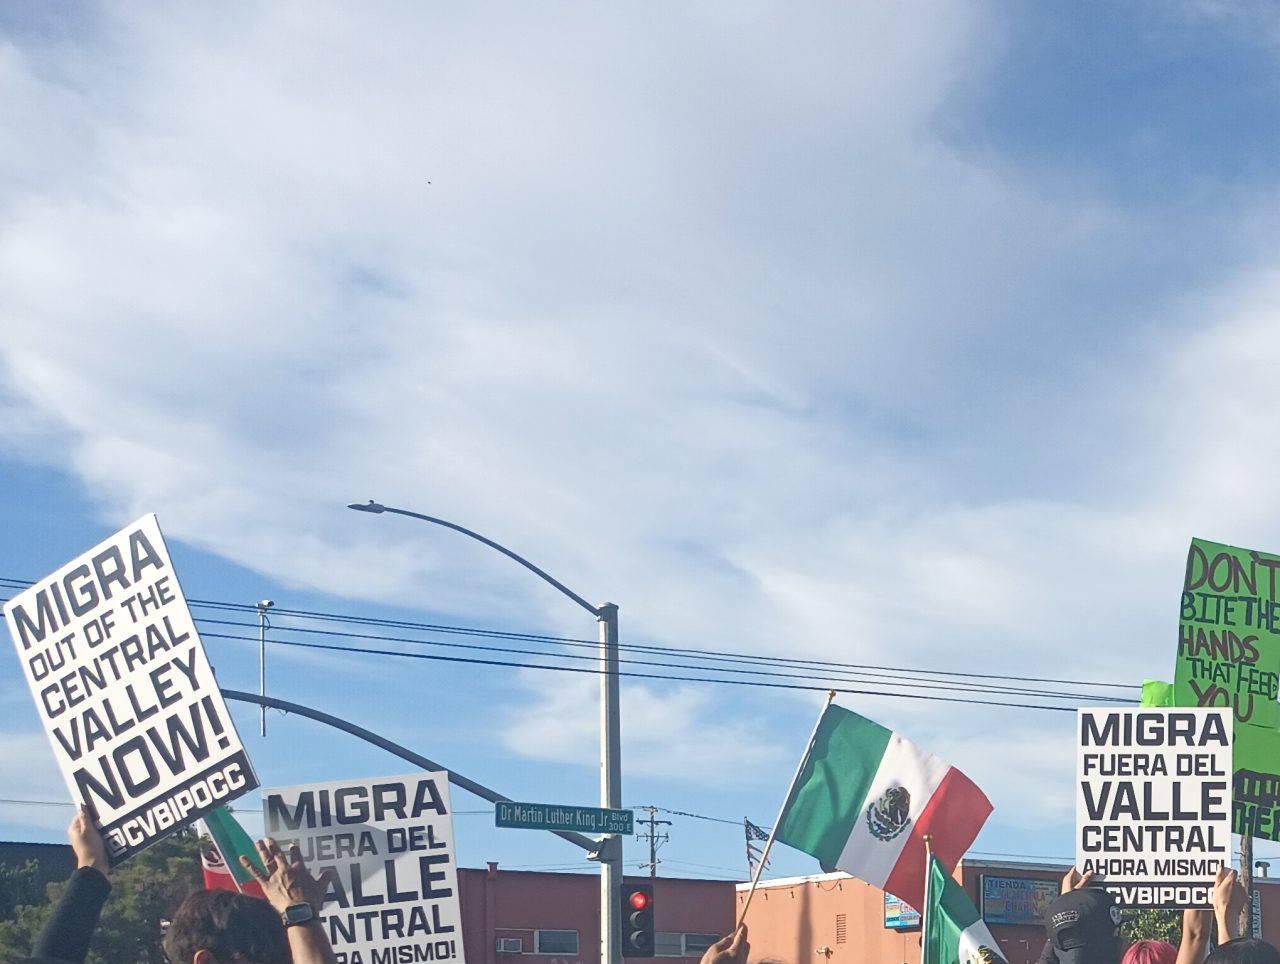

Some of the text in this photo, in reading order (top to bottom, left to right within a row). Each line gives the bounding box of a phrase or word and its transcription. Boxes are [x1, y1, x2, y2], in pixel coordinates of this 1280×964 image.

[12, 529, 164, 650] MIGRA
[1181, 591, 1236, 626] BITE
[29, 575, 176, 682] OUT OF THE
[1179, 625, 1260, 664] HANDS
[40, 615, 190, 719] CENTRAL
[1186, 657, 1279, 701] THAT FEED
[53, 647, 201, 762] VALLEY
[1189, 679, 1253, 723] YOU
[1081, 713, 1229, 746] MIGRA
[73, 695, 231, 827] NOW!
[1083, 754, 1226, 776] FUERA DEL
[104, 762, 246, 854] @CVBIPOCC
[268, 779, 448, 832] MIGRA
[501, 804, 608, 831] Dr Martin Luther King Jr
[611, 813, 628, 822] Blvd
[1081, 781, 1227, 821] VALLE
[386, 825, 446, 854] DEL
[608, 822, 631, 831] 300 E
[1082, 825, 1226, 853] CENTRAL
[320, 854, 453, 909] ALLE
[989, 879, 1026, 889] TIENDA
[1083, 859, 1149, 876] AHORA
[319, 904, 454, 945] NTRAL
